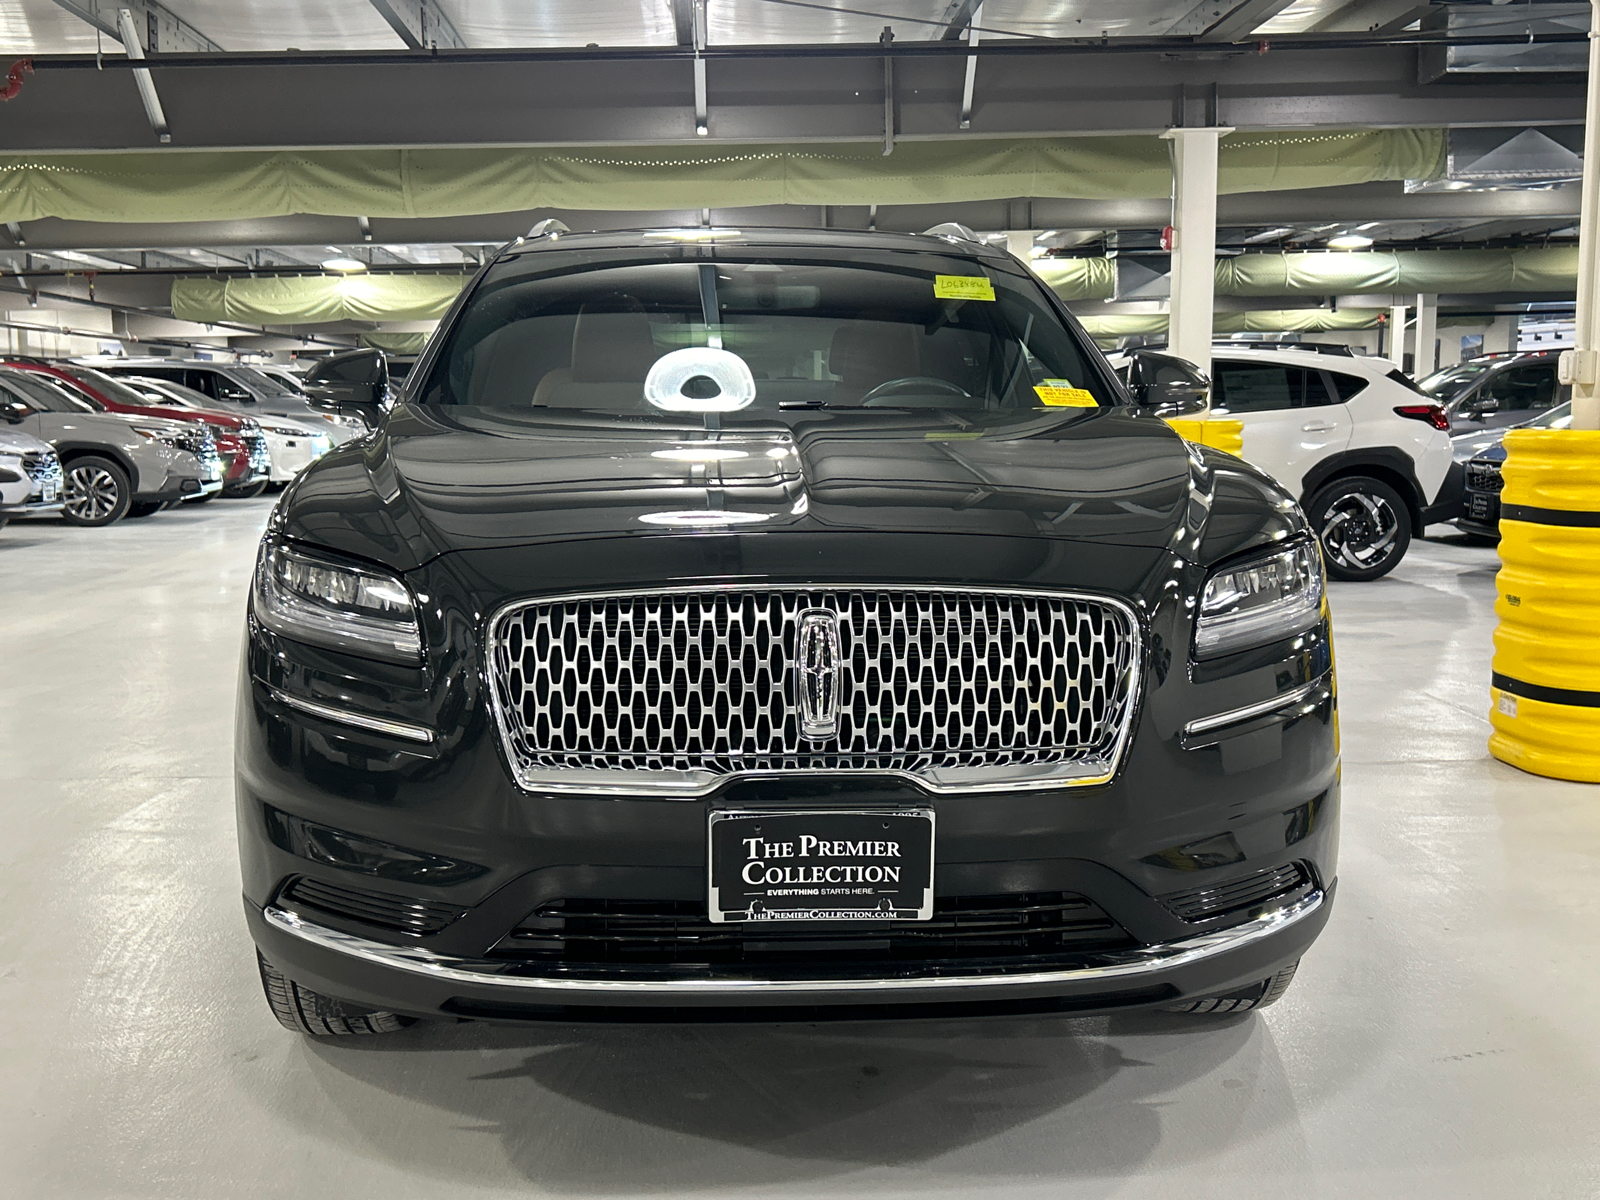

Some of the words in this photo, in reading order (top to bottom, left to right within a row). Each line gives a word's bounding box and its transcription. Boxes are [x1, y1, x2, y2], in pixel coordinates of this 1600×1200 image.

[742, 837, 794, 859] THE
[798, 835, 902, 857] PREMIER
[741, 861, 901, 885] COLLECTION
[767, 888, 820, 896] EVERYTHING
